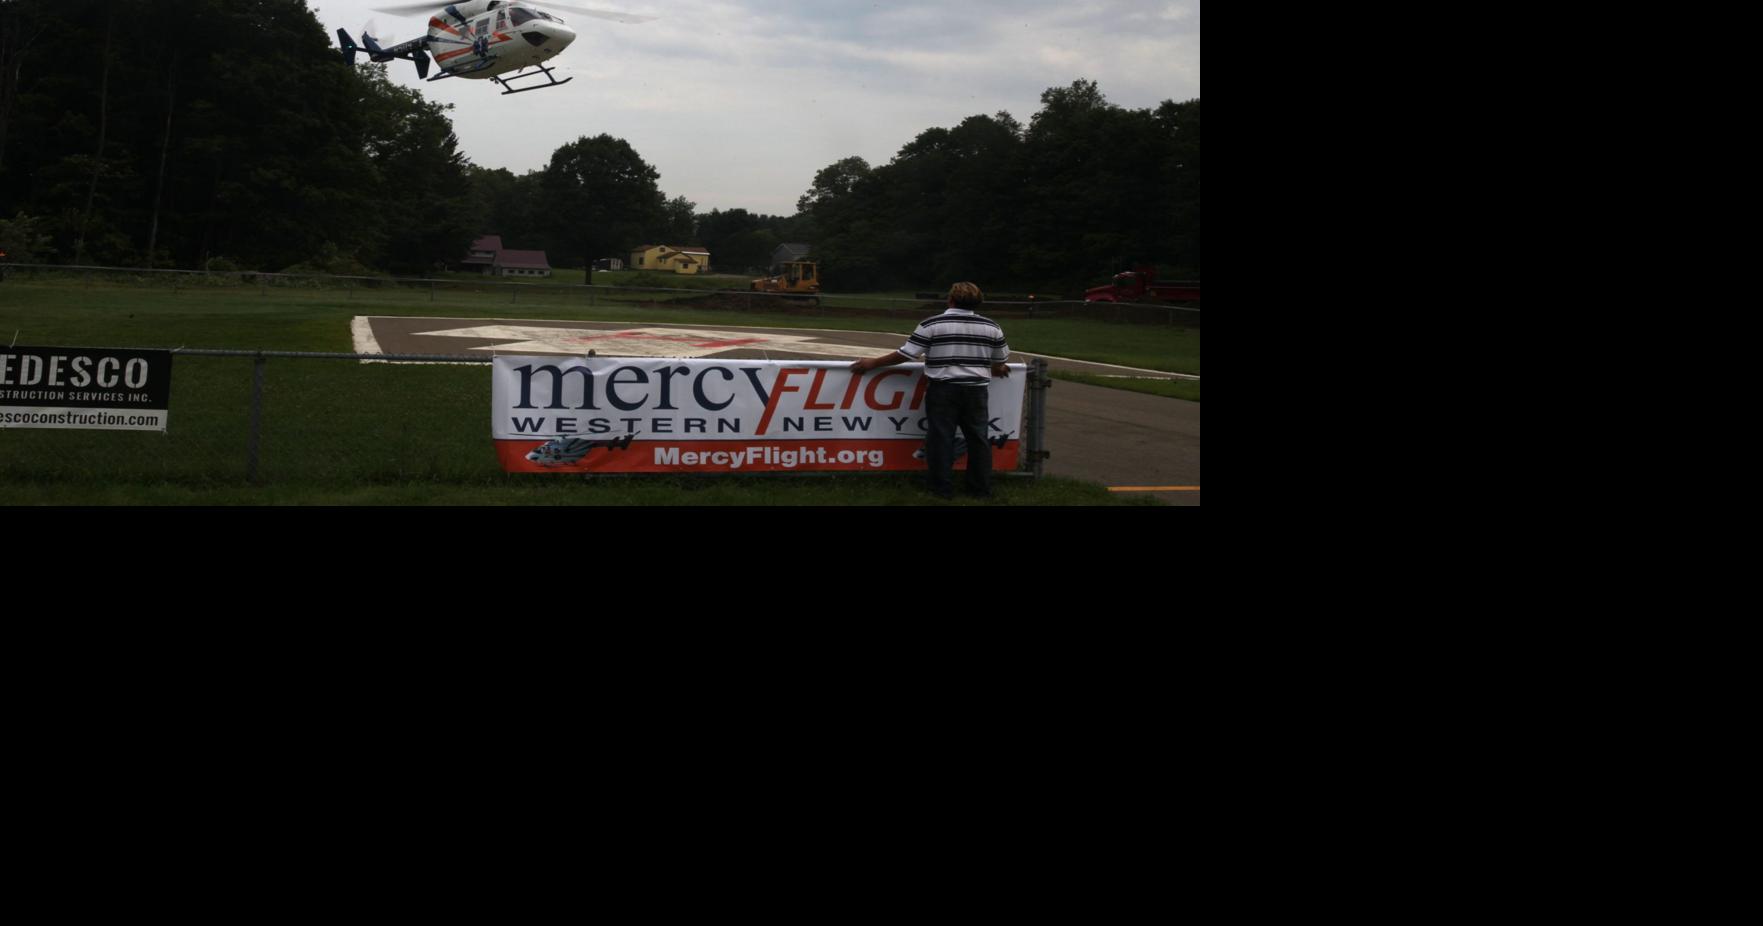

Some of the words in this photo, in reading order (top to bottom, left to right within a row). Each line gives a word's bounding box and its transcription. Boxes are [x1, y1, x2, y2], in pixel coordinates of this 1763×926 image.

[0, 354, 149, 389] EDESCO
[69, 391, 124, 402] SERVICES
[128, 393, 152, 402] INC.
[755, 367, 929, 435] FLIG
[511, 417, 741, 434] WESTERN
[783, 416, 873, 432] NEW
[888, 417, 1003, 432] YK
[654, 446, 884, 468] MercyFlight.org
